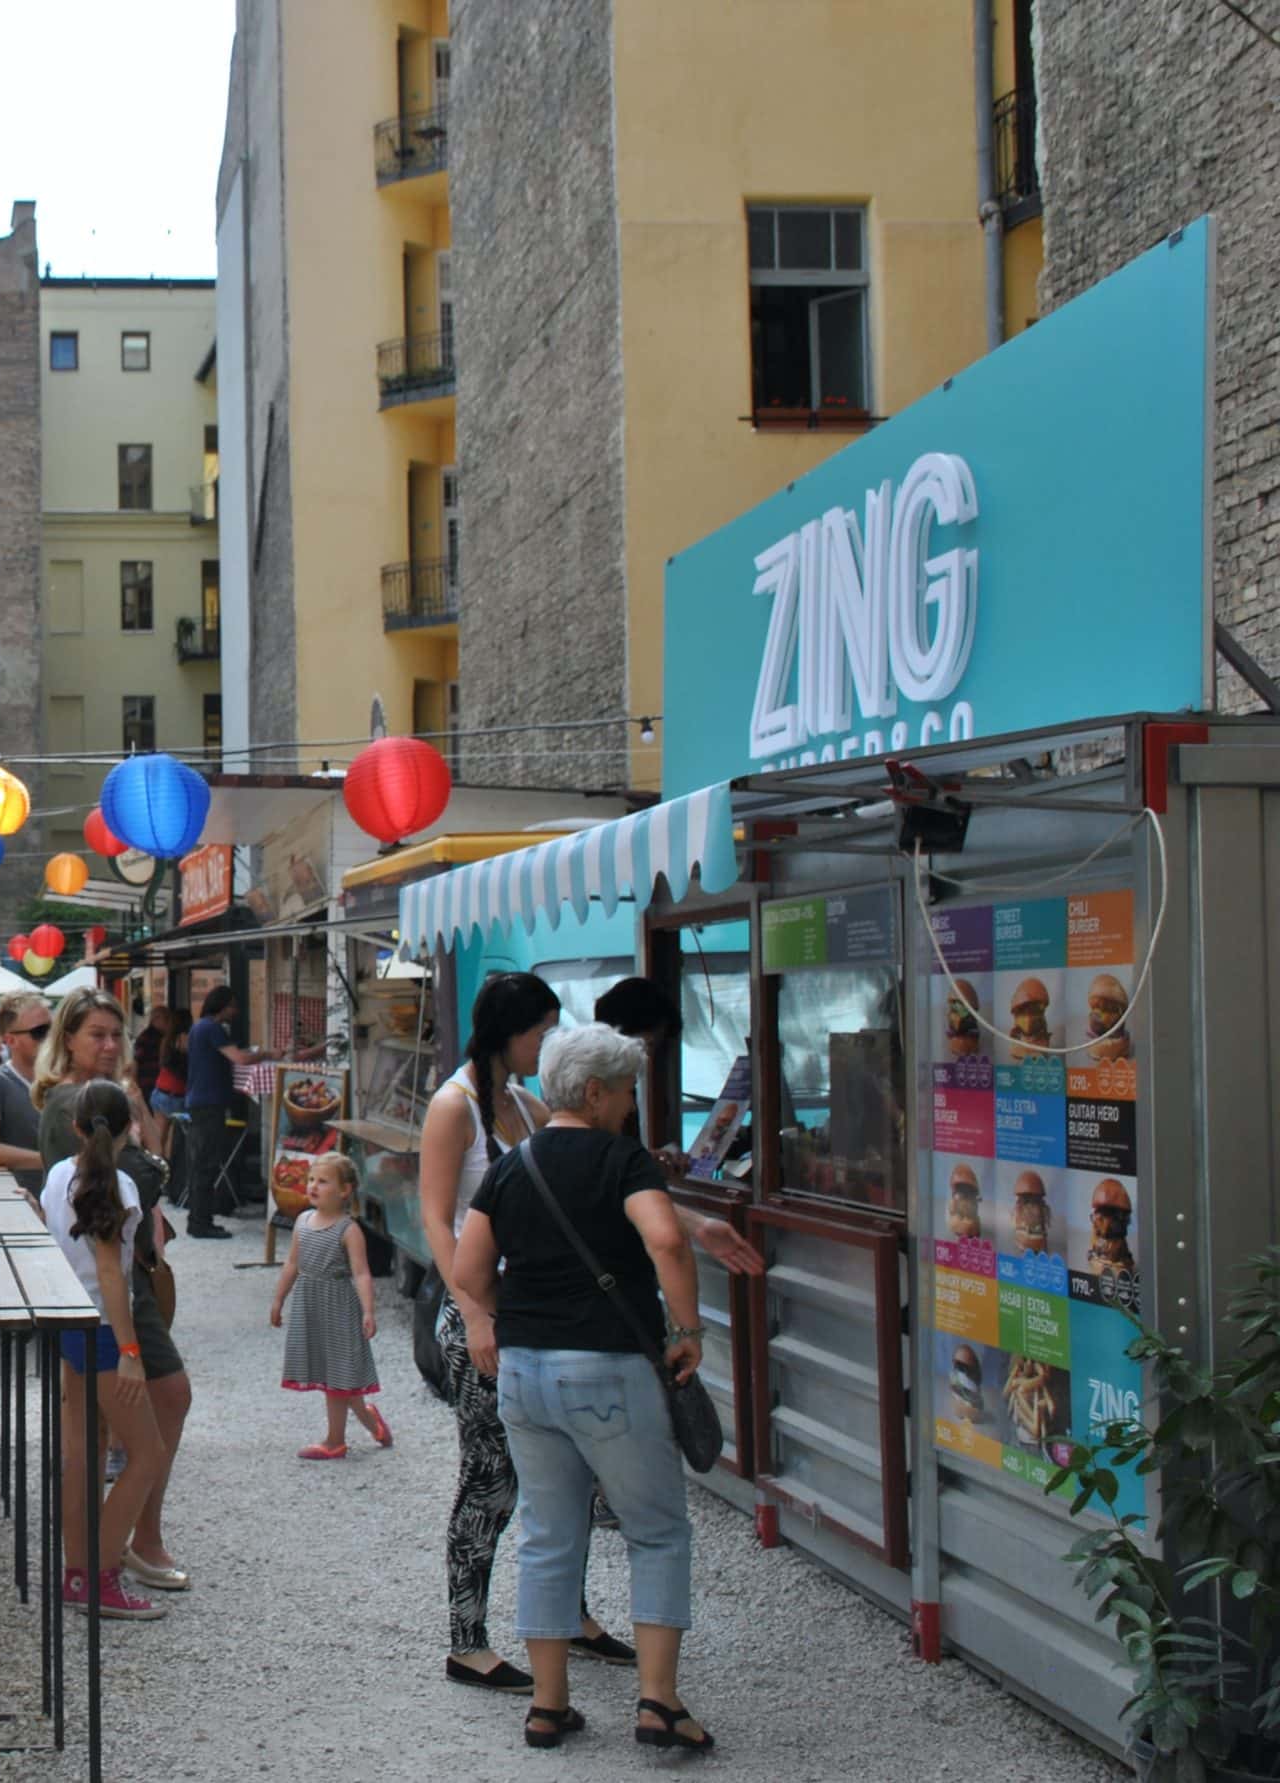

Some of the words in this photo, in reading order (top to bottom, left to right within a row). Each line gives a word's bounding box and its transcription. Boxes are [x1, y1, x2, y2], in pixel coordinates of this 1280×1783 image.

[749, 452, 978, 759] ZING
[1069, 917, 1101, 935] BURGER
[1069, 1103, 1096, 1120] GUITAR
[1097, 1106, 1119, 1122] HERO
[1069, 1121, 1100, 1139] BURGER
[1027, 1295, 1051, 1316] EXTRA
